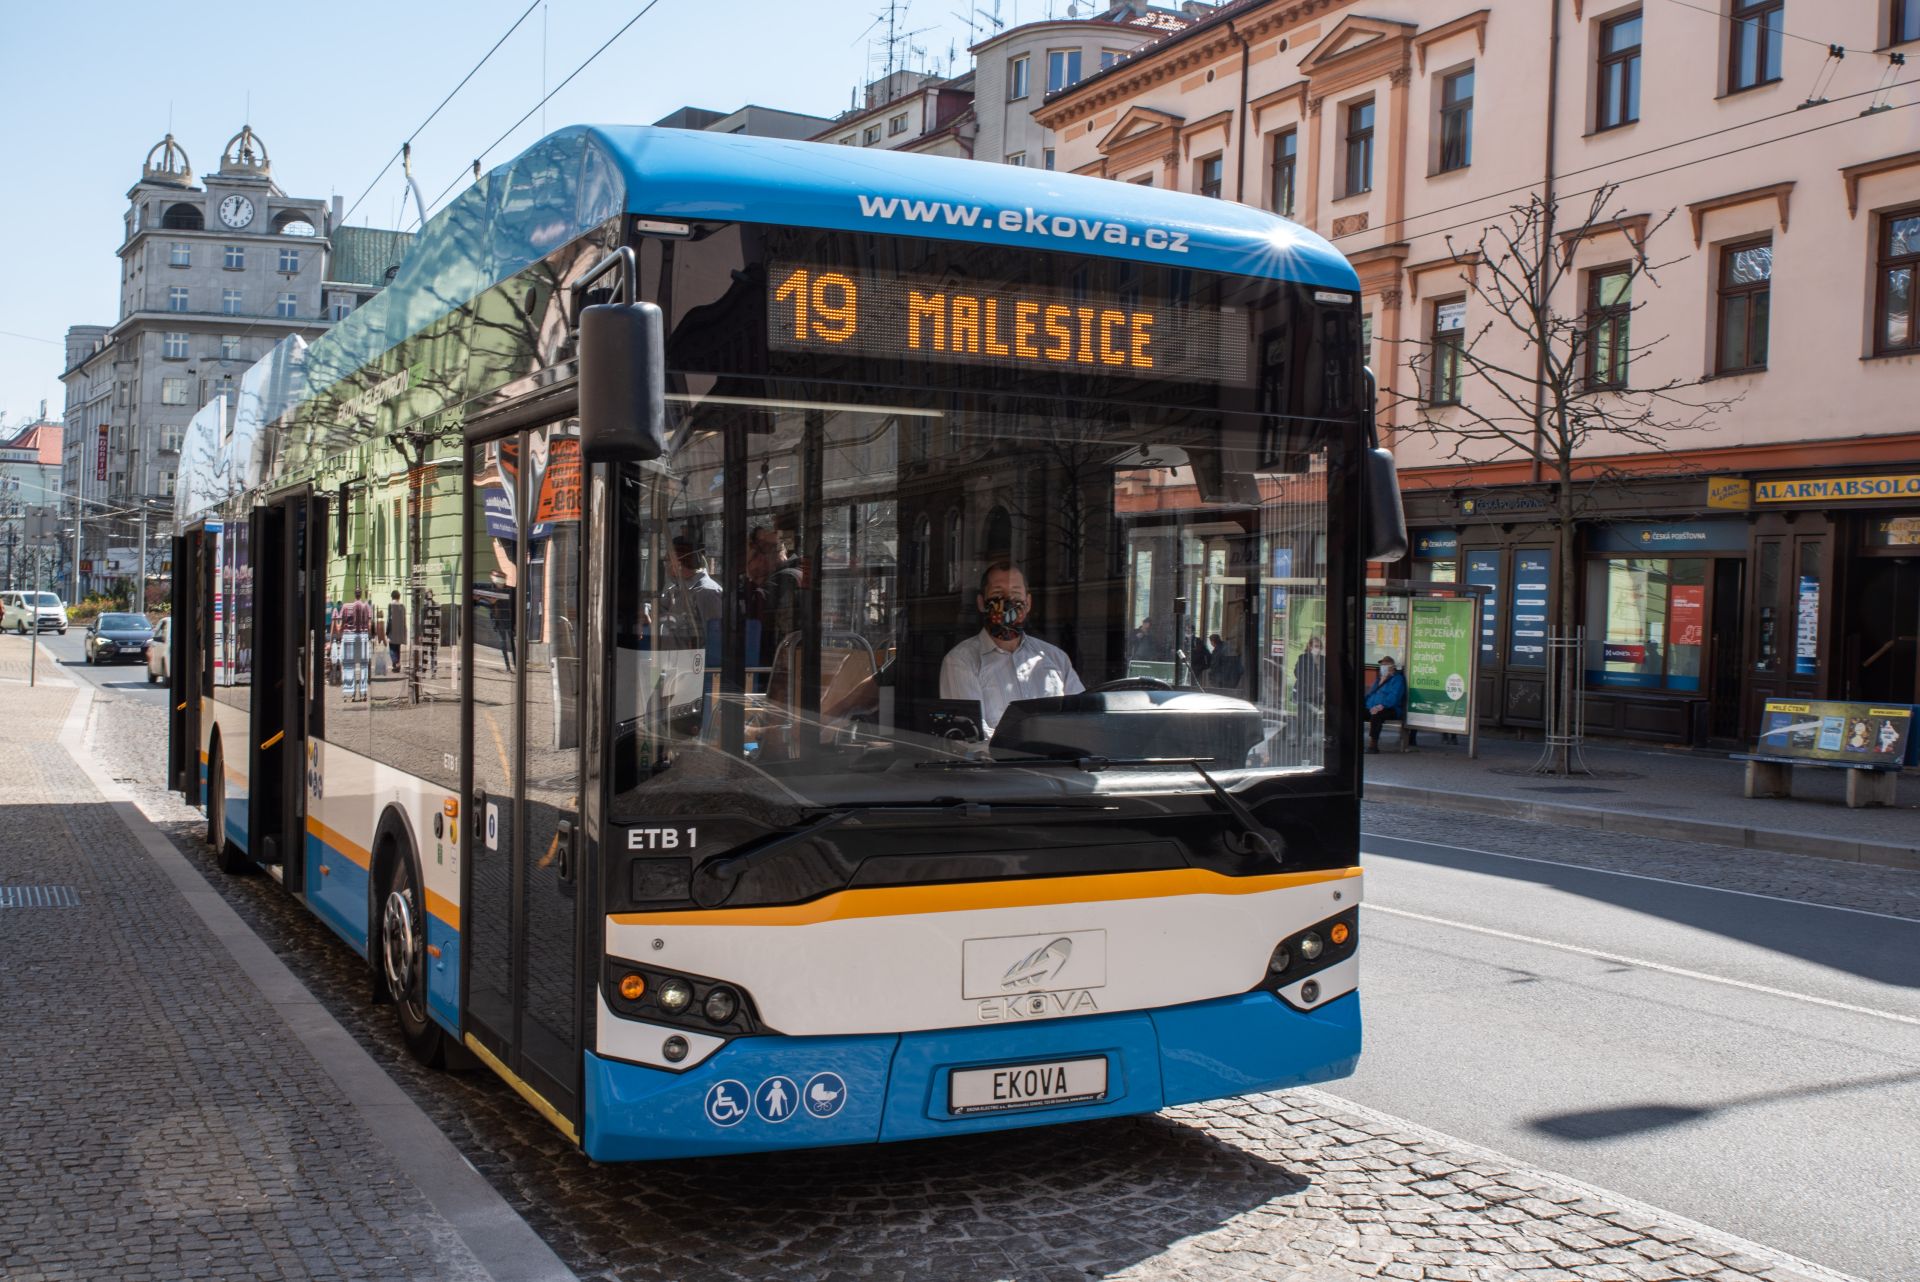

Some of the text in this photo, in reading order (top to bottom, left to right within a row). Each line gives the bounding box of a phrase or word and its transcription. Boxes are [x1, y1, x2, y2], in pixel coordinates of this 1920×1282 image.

[857, 195, 1190, 253] www.ekova.cz
[776, 269, 1153, 367] 19 MALESICE
[337, 392, 363, 421] EKOVA
[1652, 531, 1671, 540] ČESKÁ
[1425, 626, 1466, 639] PLZEŇÁKY
[444, 753, 454, 770] ETB
[628, 827, 697, 849] ETB 1
[978, 990, 1099, 1021] EKOVA
[994, 1066, 1067, 1100] EKOVA
